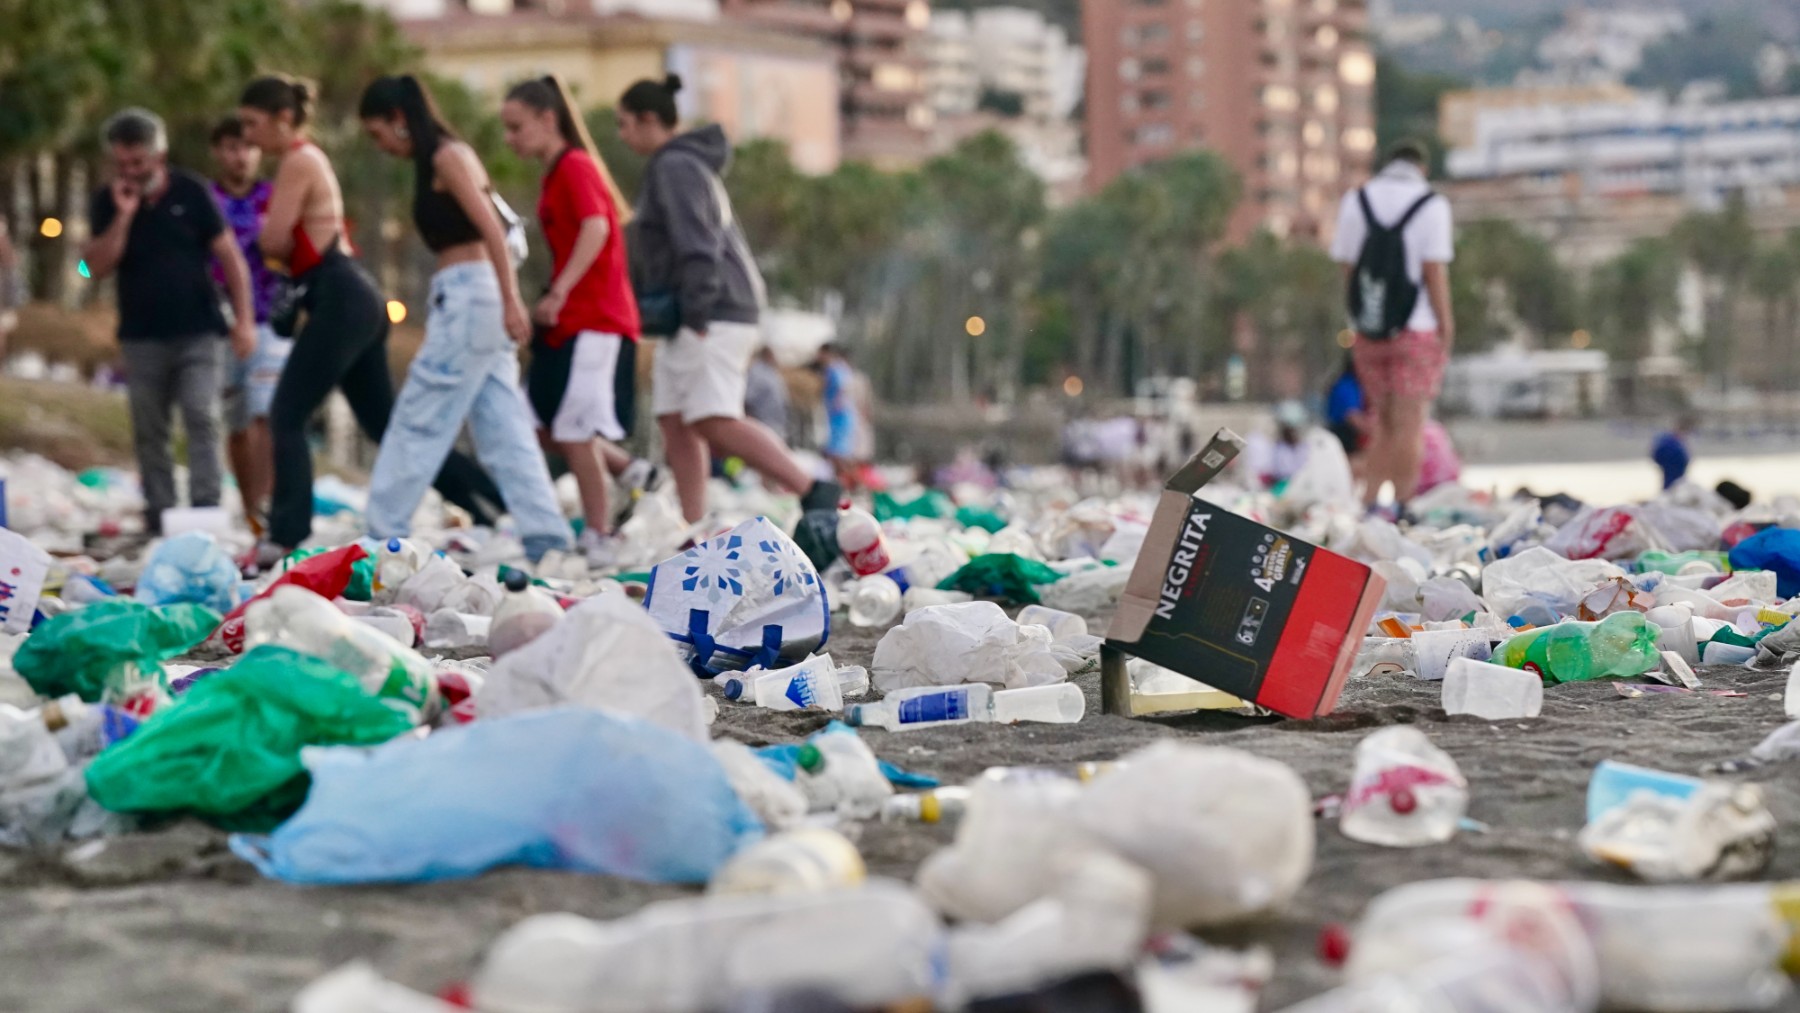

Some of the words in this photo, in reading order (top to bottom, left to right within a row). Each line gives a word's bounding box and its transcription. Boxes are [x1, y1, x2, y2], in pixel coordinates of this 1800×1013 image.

[1156, 513, 1212, 620] NEGRITA
[1273, 543, 1290, 581] GRATIS
[1253, 577, 1275, 593] 4
